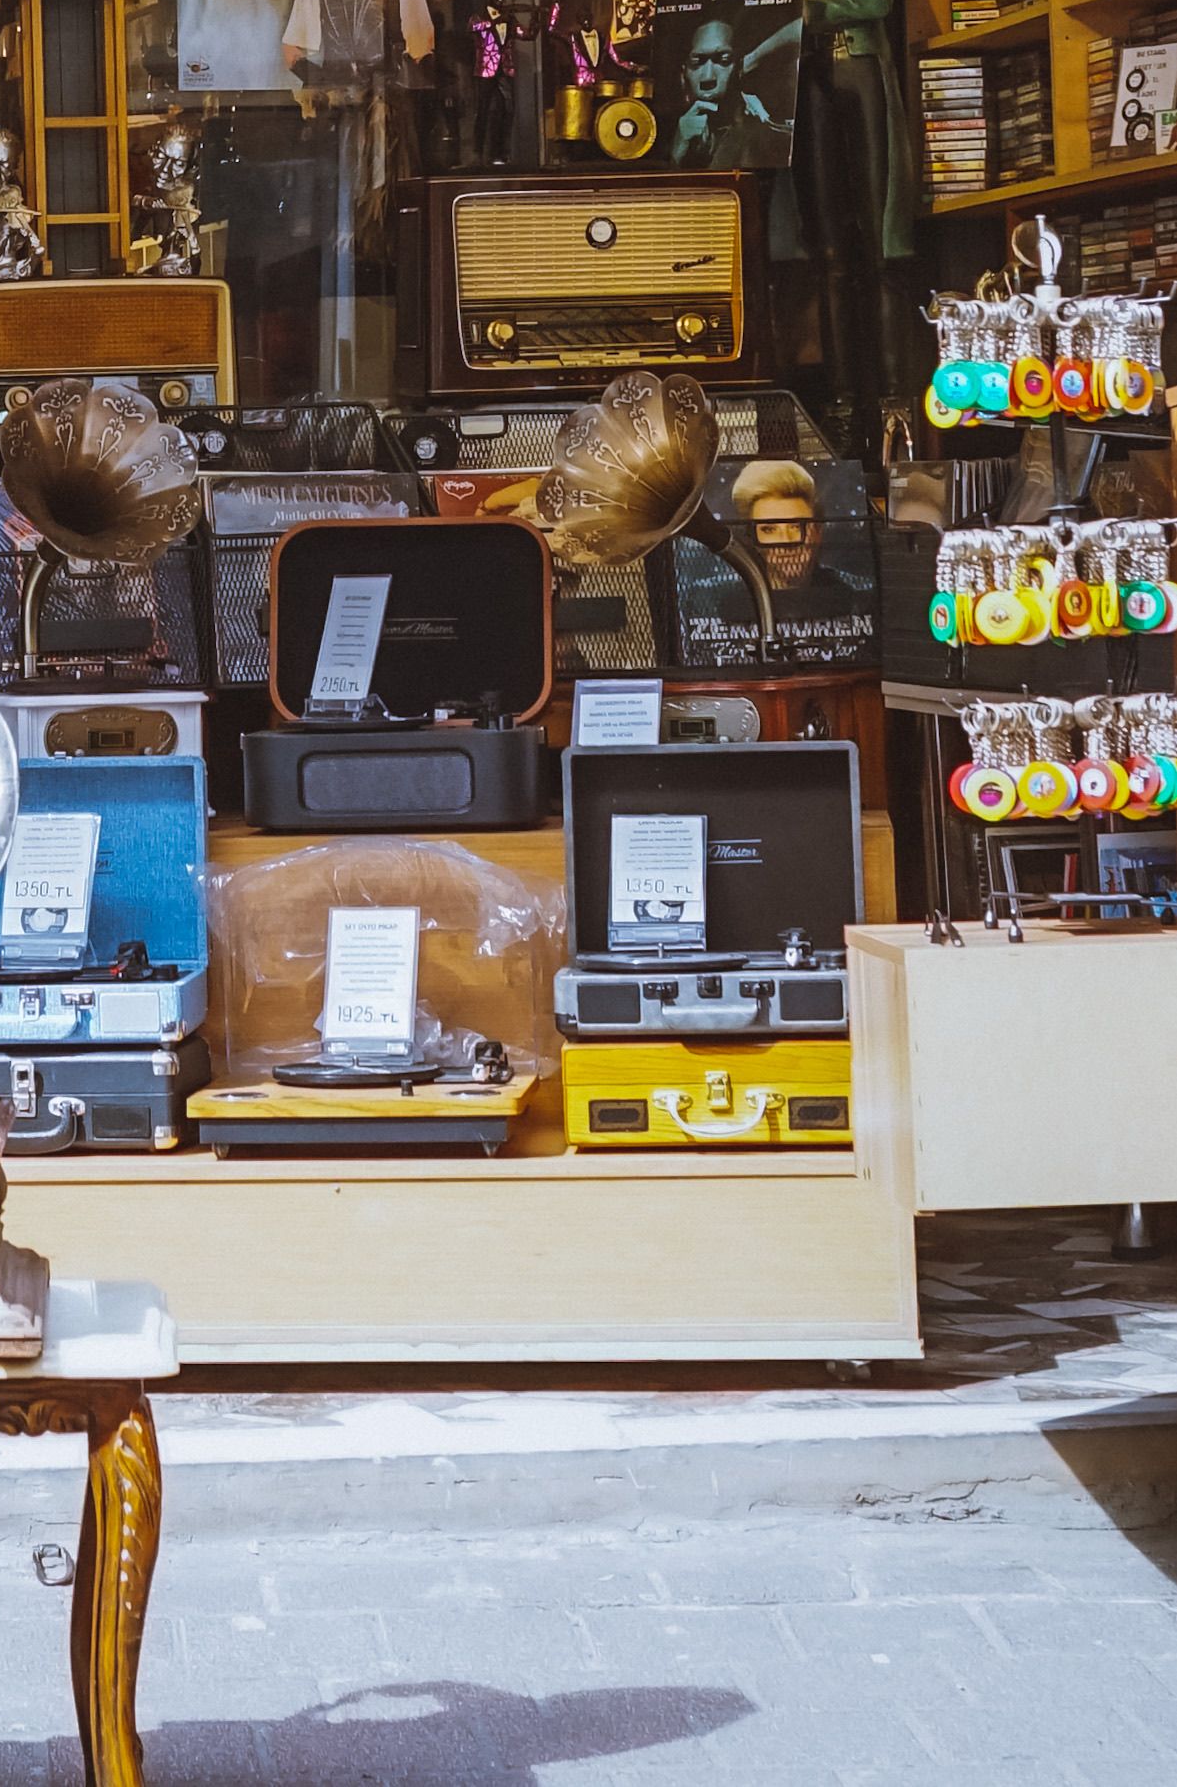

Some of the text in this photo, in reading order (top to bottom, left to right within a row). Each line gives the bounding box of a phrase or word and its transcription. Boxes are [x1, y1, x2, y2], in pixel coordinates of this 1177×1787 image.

[677, 3, 702, 12] TRAIN
[55, 886, 73, 898] TL
[673, 885, 693, 894] TL
[338, 1005, 399, 1023] 1925 TL
